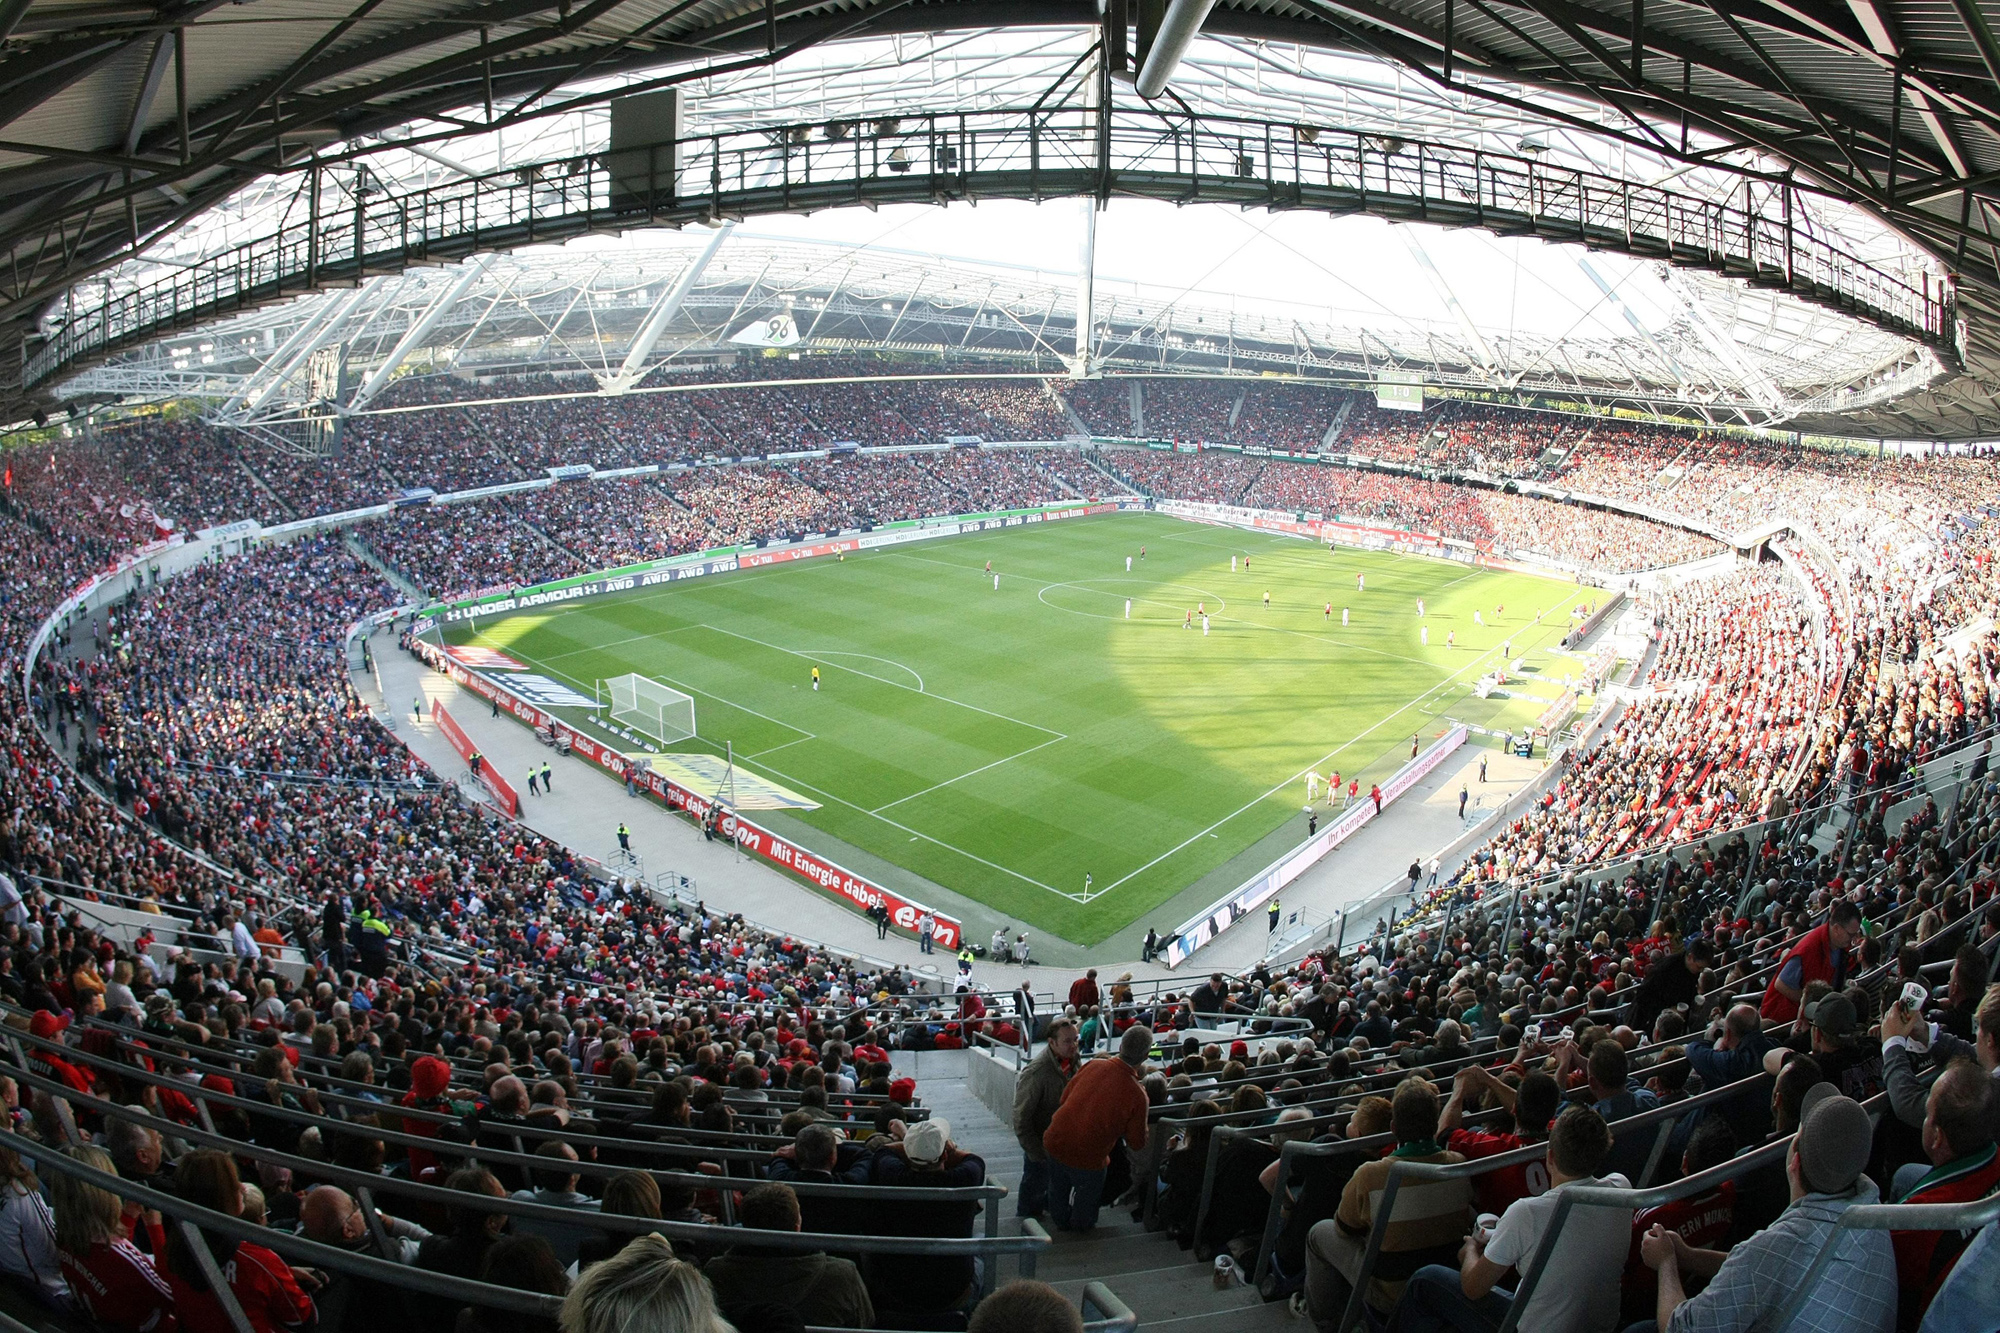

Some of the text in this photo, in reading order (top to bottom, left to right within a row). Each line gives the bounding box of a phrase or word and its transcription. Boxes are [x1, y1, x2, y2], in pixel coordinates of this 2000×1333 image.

[768, 316, 791, 339] 96
[213, 523, 250, 538] AWD
[962, 524, 980, 533] AWD
[984, 520, 1002, 530] AWD
[1006, 518, 1022, 526] AWD
[1026, 514, 1042, 524] AWD
[1448, 552, 1474, 562] AWD
[606, 560, 738, 592] AWD AWD AWD AWD
[464, 600, 516, 618] UNDER
[520, 587, 584, 608] ARMOUR
[412, 619, 434, 635] AWD
[1328, 828, 1339, 846] Ihr
[1385, 746, 1446, 800] Veranstaltungspartner
[575, 736, 594, 756] dabei
[652, 777, 684, 806] Enrgie
[686, 797, 710, 819] dabe
[770, 840, 792, 864] Mit
[794, 852, 840, 888] Energie
[844, 881, 882, 908] dabei
